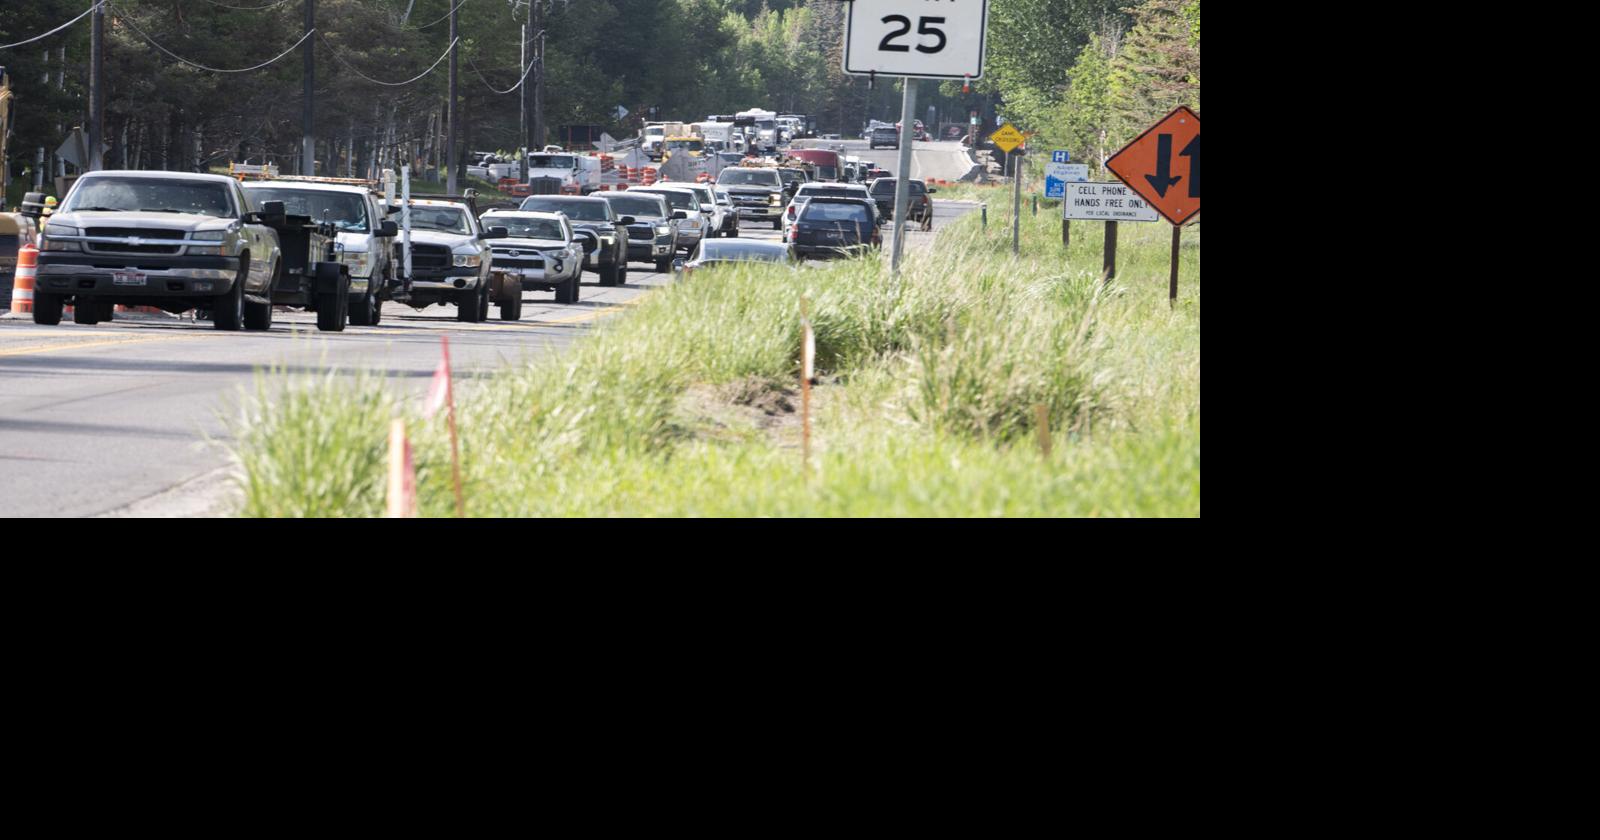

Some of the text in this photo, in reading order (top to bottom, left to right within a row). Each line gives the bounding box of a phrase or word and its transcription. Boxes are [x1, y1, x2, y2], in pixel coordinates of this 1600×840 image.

[878, 14, 947, 54] 25
[1055, 151, 1066, 162] H
[1078, 186, 1097, 195] CELL
[1102, 186, 1127, 196] PHONE
[1074, 198, 1100, 207] HANDS
[1105, 199, 1124, 208] FREE
